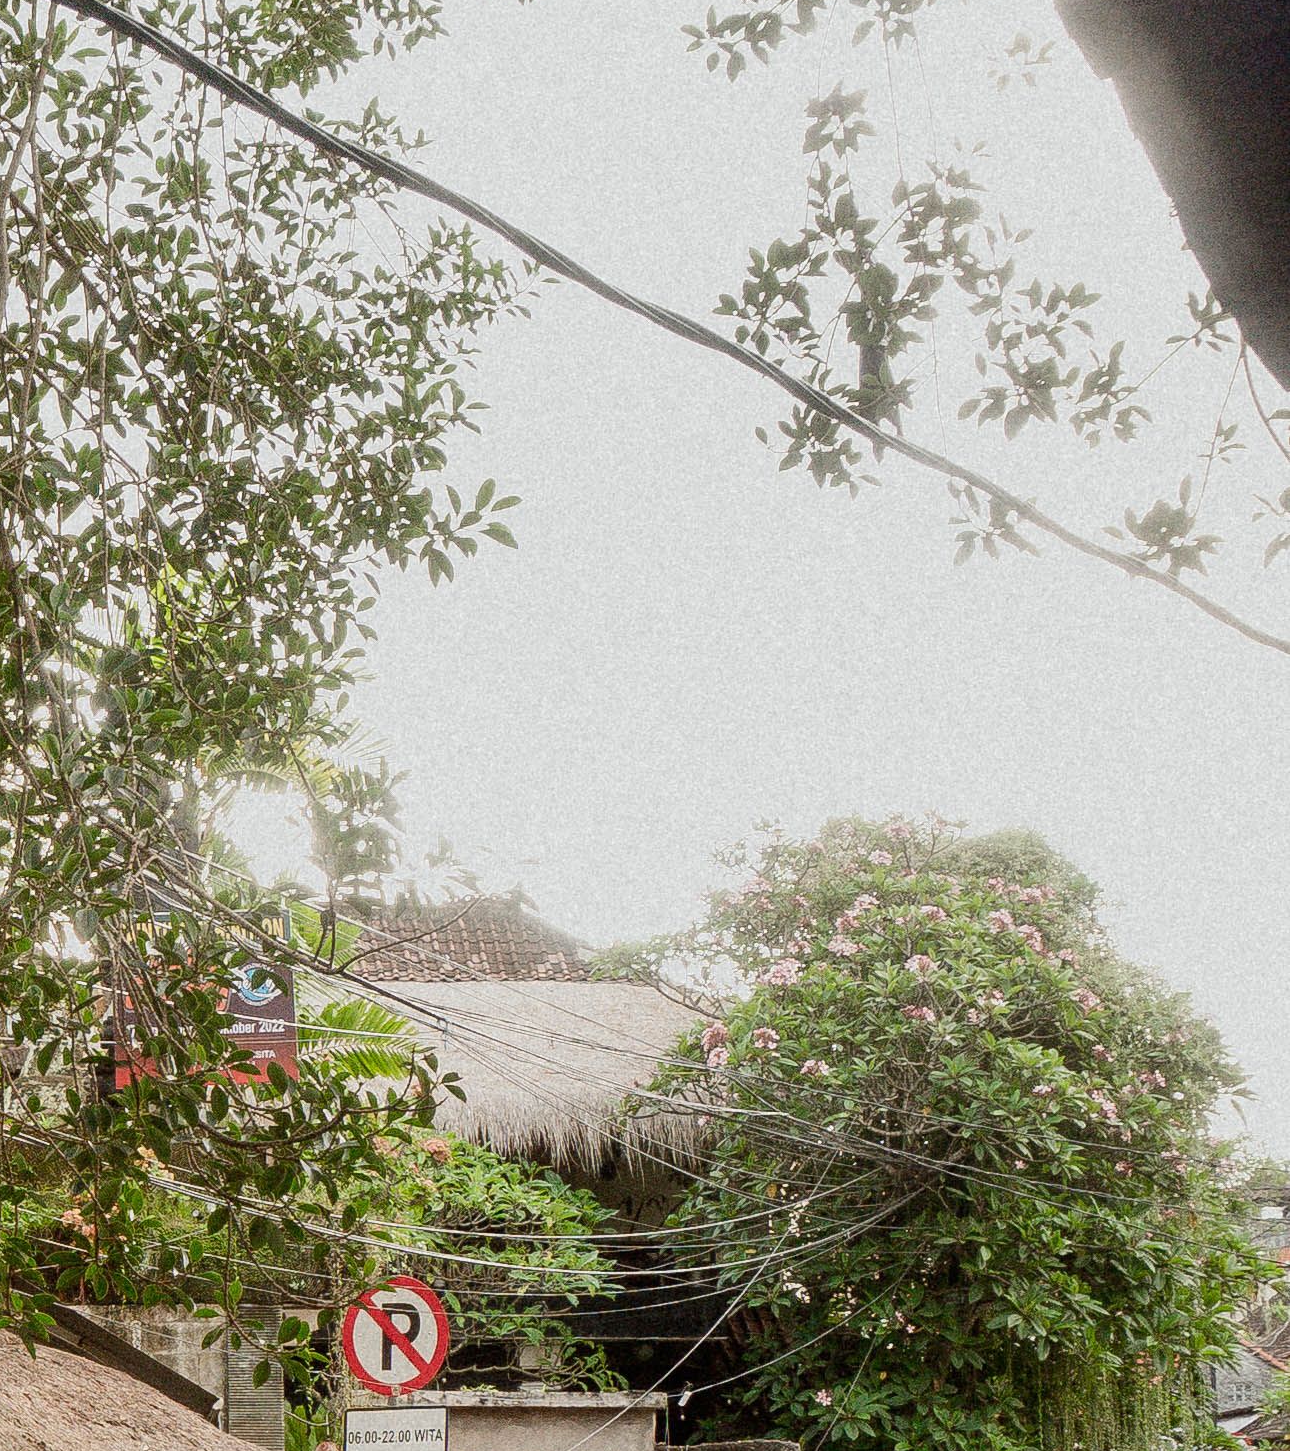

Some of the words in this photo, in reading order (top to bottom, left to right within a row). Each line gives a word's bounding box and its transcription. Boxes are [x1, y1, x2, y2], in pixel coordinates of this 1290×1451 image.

[258, 1019, 285, 1033] 2022
[348, 1430, 411, 1444] 06.00-22.00
[415, 1429, 443, 1442] WITA
